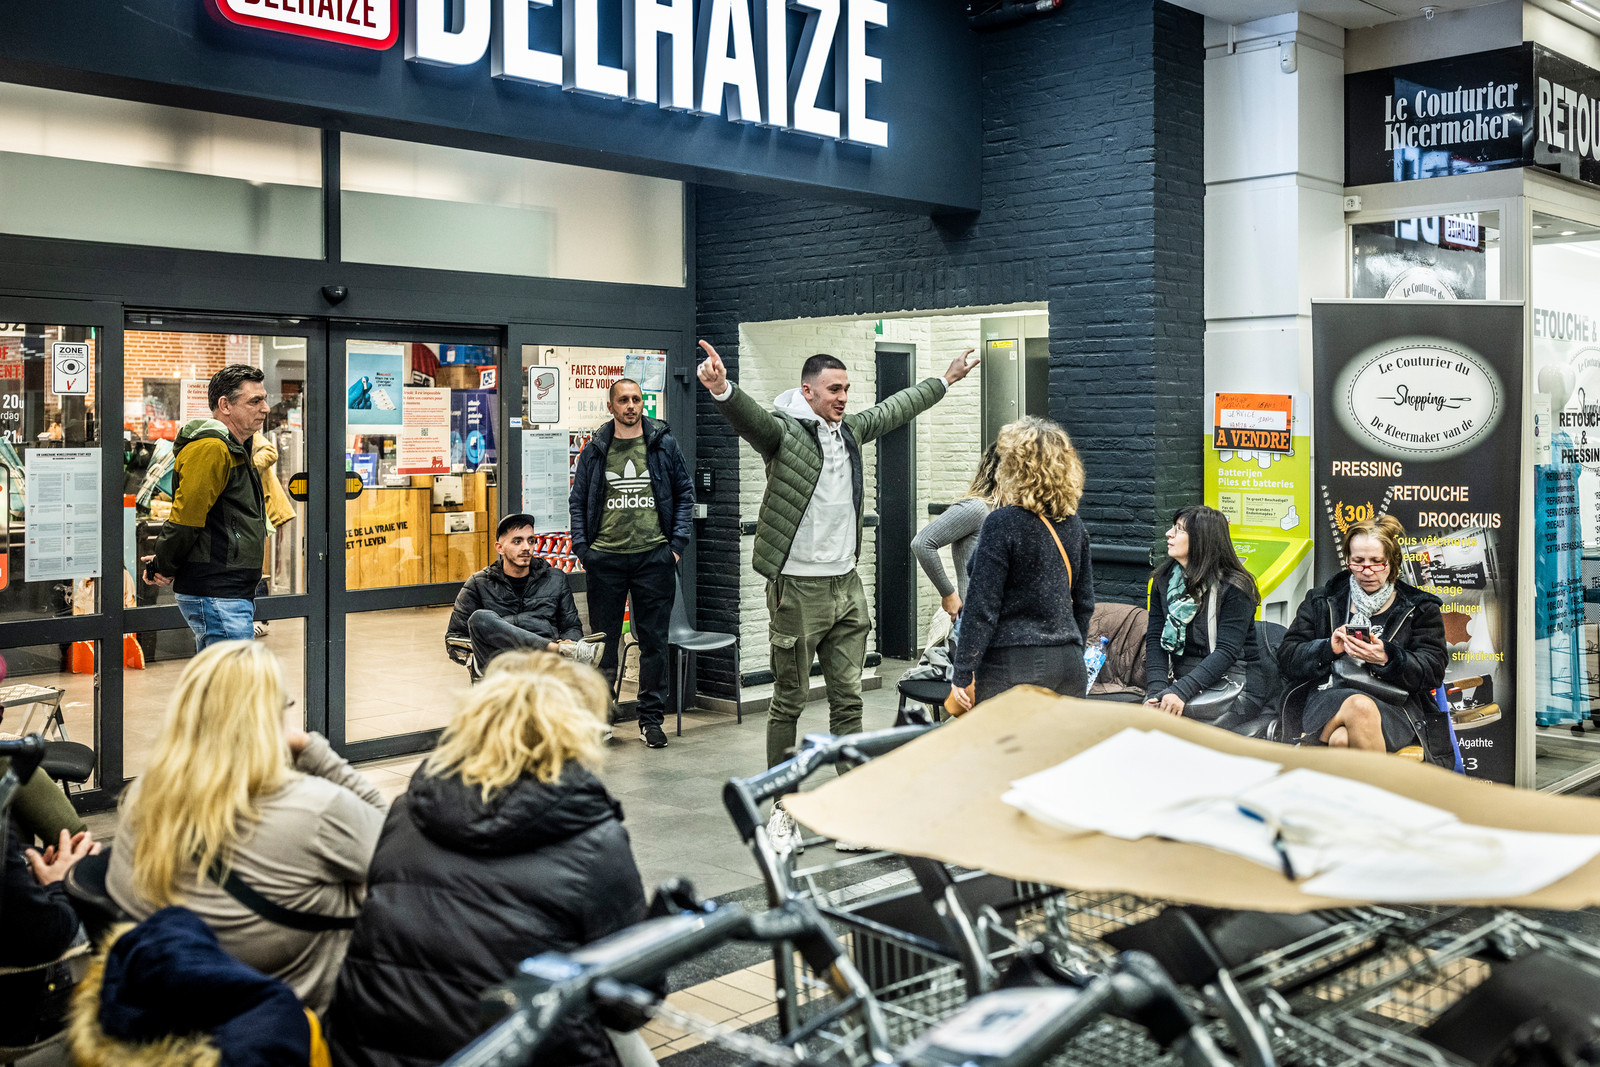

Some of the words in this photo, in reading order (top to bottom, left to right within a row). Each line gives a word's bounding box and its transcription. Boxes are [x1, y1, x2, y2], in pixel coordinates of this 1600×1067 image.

[1385, 95, 1407, 122] Le
[1415, 81, 1518, 119] Couturier
[1385, 113, 1513, 151] Kleermaker
[1534, 308, 1589, 342] ETOUCHE
[571, 364, 596, 376] FAITES
[598, 366, 624, 376] COMME
[1378, 360, 1394, 375] Le
[1396, 356, 1453, 371] Couturier
[1454, 362, 1470, 376] du
[575, 378, 594, 389] CHEZ
[2, 394, 24, 409] 20u
[1394, 384, 1459, 411] Shopping
[578, 401, 587, 411] DE
[0, 411, 20, 422] rdag
[1370, 416, 1383, 428] De
[1384, 424, 1440, 443] Kleermaker
[1443, 428, 1461, 440] van
[1462, 418, 1474, 430] de
[1216, 429, 1228, 446] A
[1230, 430, 1289, 450] VENDRE
[1581, 430, 1587, 445] &
[1218, 468, 1262, 479] Batterijen
[1332, 461, 1402, 478] PRESSING
[1218, 478, 1239, 486] Piles
[1253, 479, 1294, 489] batteries
[1394, 485, 1469, 502] RETOUCHE
[607, 494, 655, 509] adidas
[1344, 504, 1366, 522] 30
[1565, 506, 1580, 516] RAPIDE
[1418, 512, 1501, 528] DROOGKUIS
[354, 528, 363, 536] DE
[364, 526, 374, 535] LA
[375, 523, 395, 533] VRAIE
[396, 521, 408, 530] VIE
[346, 541, 355, 549] ET
[364, 536, 386, 547] LEVEN
[1420, 535, 1478, 546] vêtements
[1561, 540, 1585, 552] REPASSAGE
[1403, 552, 1429, 562] eaux
[1413, 585, 1464, 597] passage
[1452, 650, 1504, 664] strijkdienst
